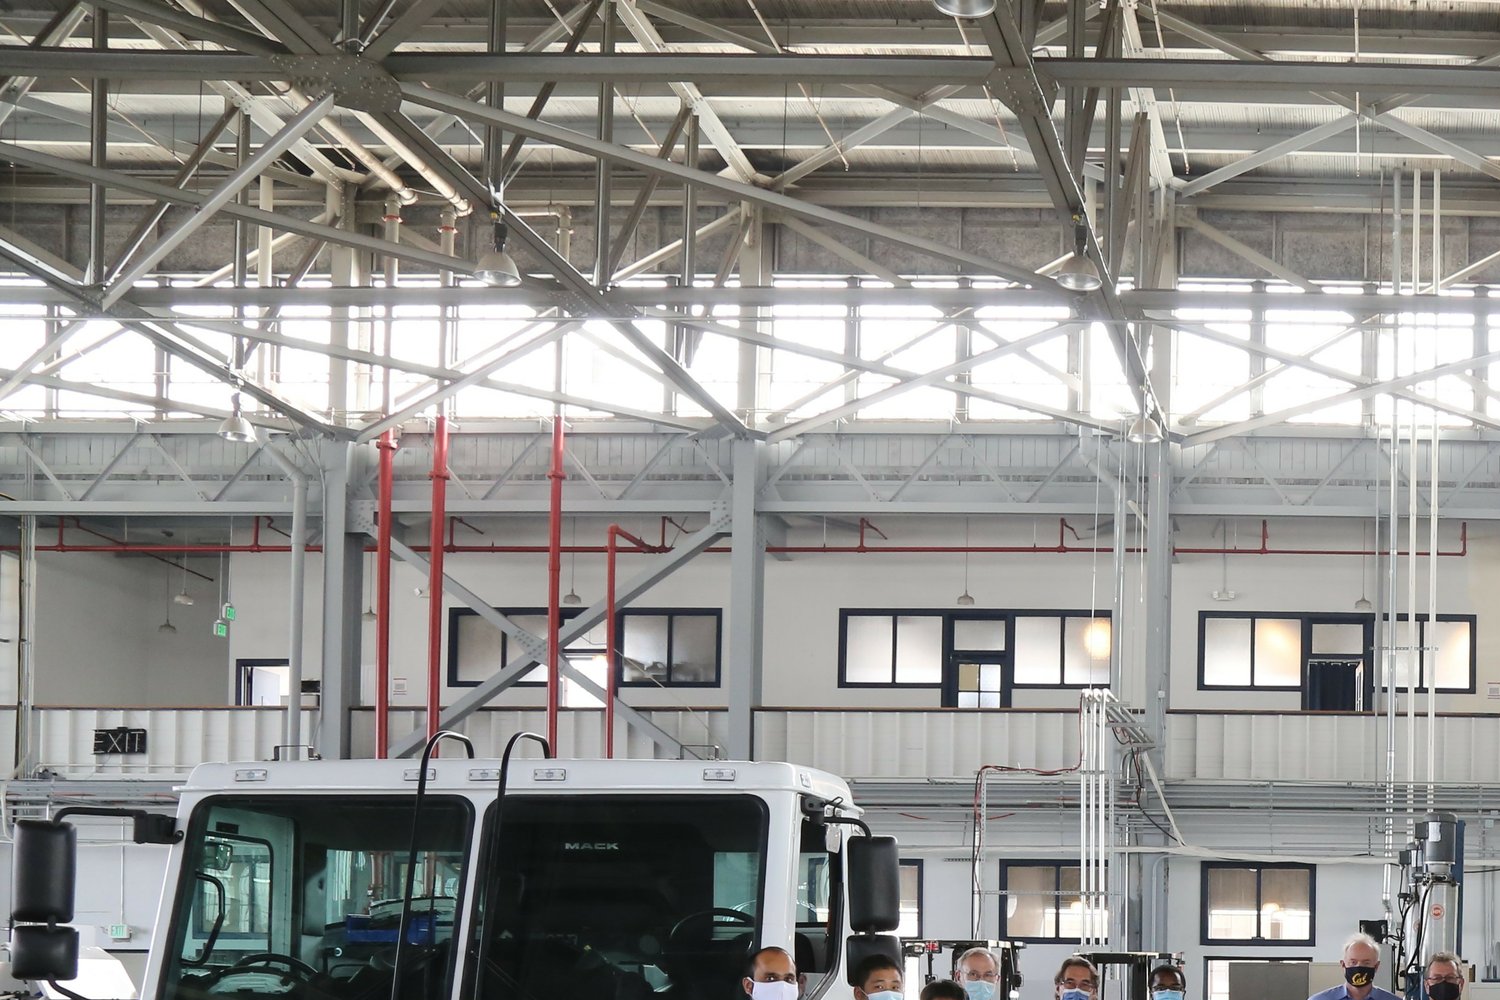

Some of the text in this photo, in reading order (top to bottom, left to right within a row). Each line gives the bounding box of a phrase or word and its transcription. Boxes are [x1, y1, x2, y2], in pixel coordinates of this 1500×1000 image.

[93, 731, 145, 753] EXIT
[564, 842, 620, 850] MACK
[1351, 972, 1368, 986] Cal
